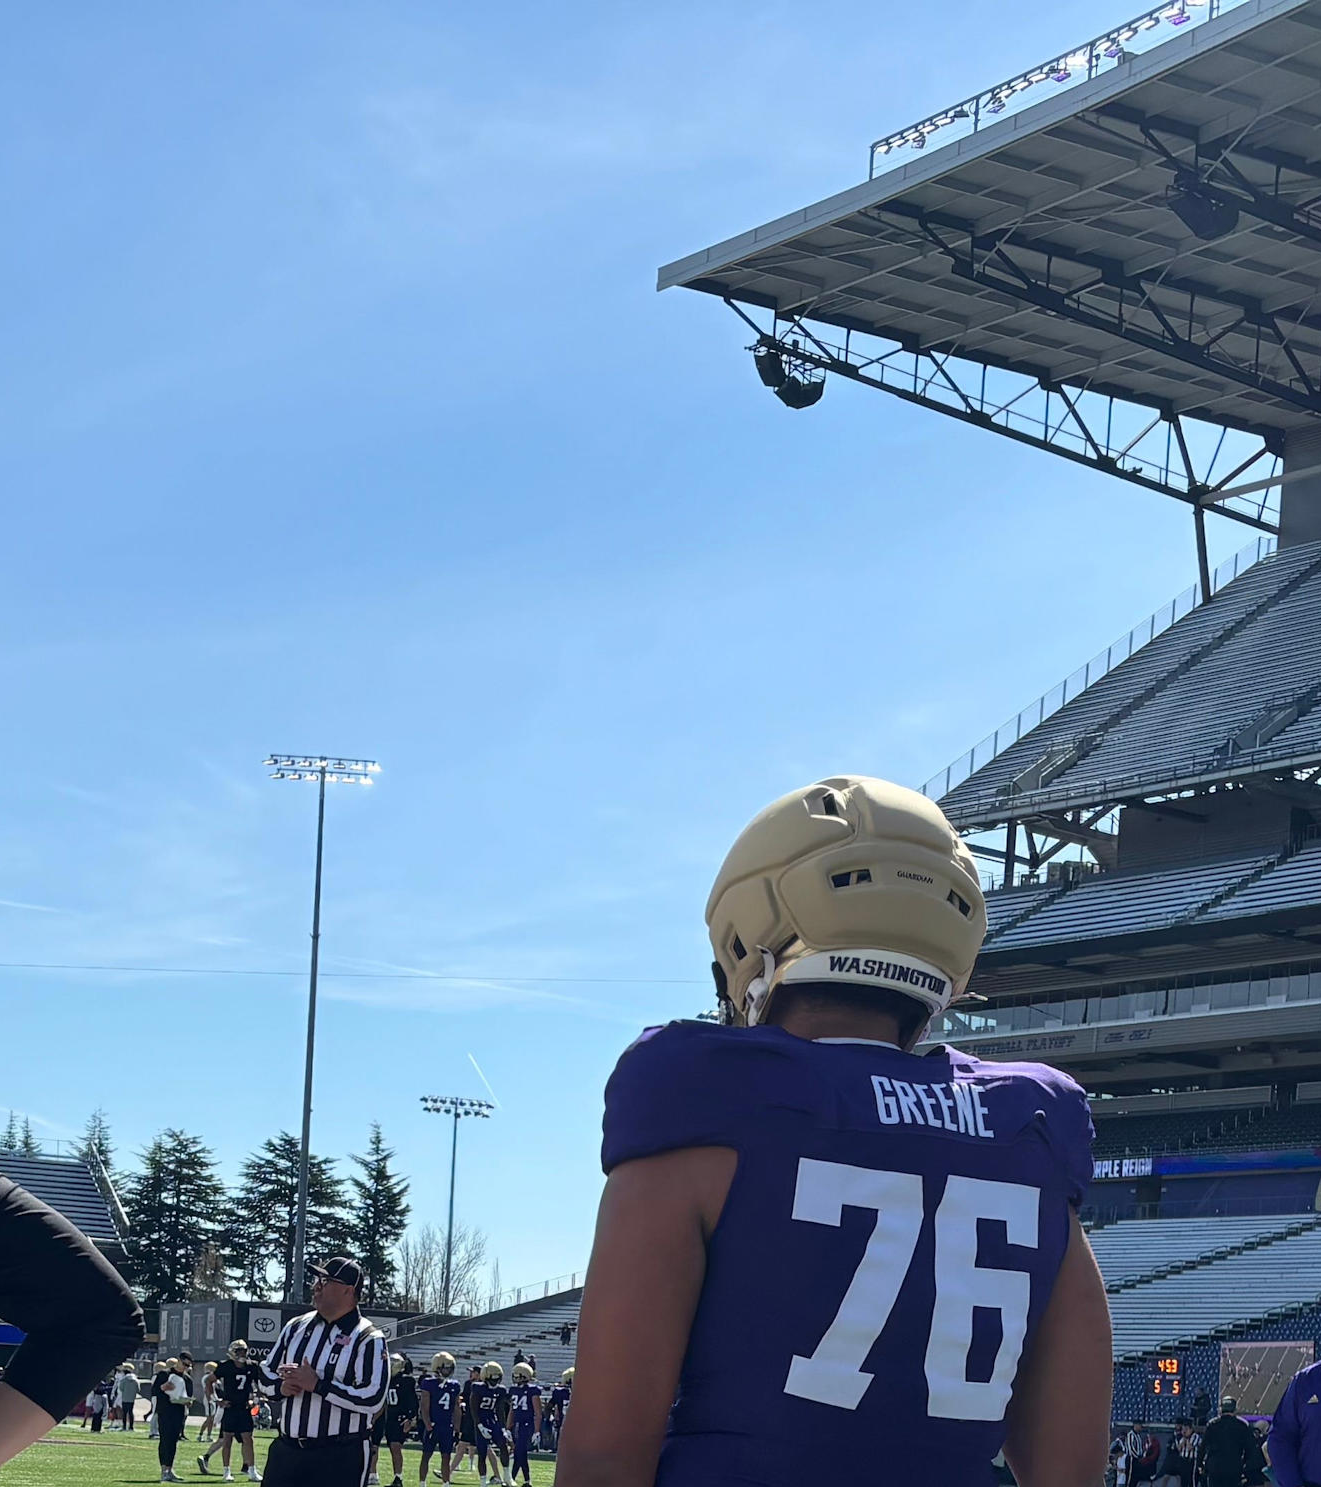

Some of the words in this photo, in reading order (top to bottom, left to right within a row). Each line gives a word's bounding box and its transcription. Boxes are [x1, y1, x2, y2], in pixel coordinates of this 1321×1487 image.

[829, 955, 947, 996] WASHINGTON
[870, 1073, 995, 1139] GREENE
[1121, 1158, 1153, 1177] REIGN
[783, 1156, 1041, 1422] 76
[328, 1353, 338, 1364] U
[235, 1374, 247, 1390] 7
[438, 1392, 451, 1410] 4
[480, 1397, 497, 1410] 21
[512, 1395, 528, 1410] 34
